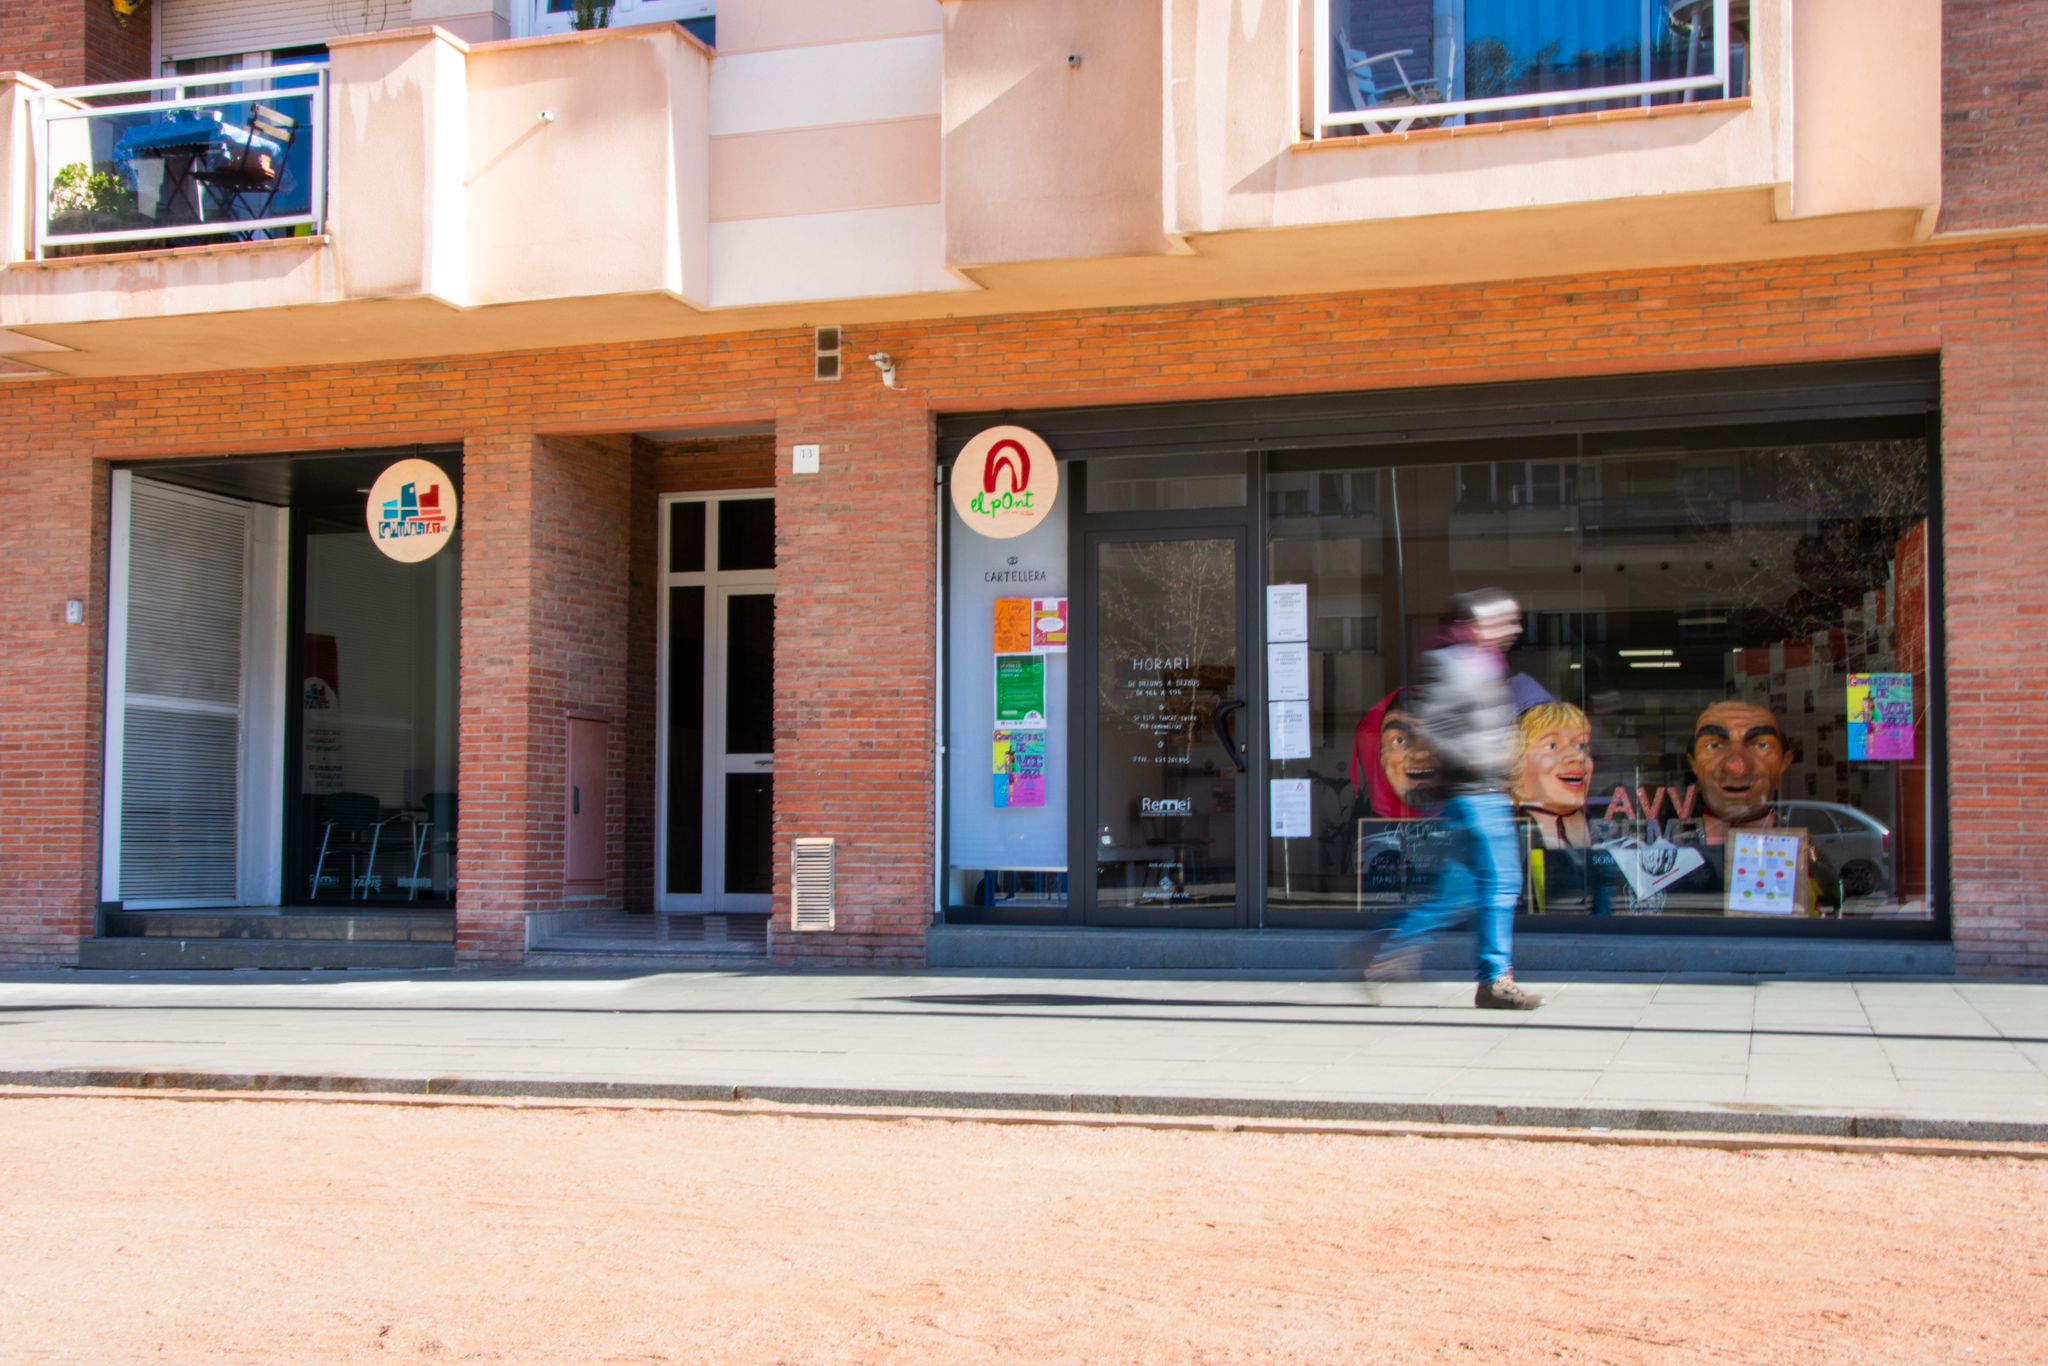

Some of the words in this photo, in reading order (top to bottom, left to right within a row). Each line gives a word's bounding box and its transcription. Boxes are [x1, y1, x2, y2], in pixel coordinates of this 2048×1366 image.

[970, 491, 990, 515] el
[984, 571, 1047, 582] CARTELLERA
[1132, 657, 1189, 671] HORARI
[1142, 797, 1191, 811] Remei
[1604, 784, 1697, 820] AVV
